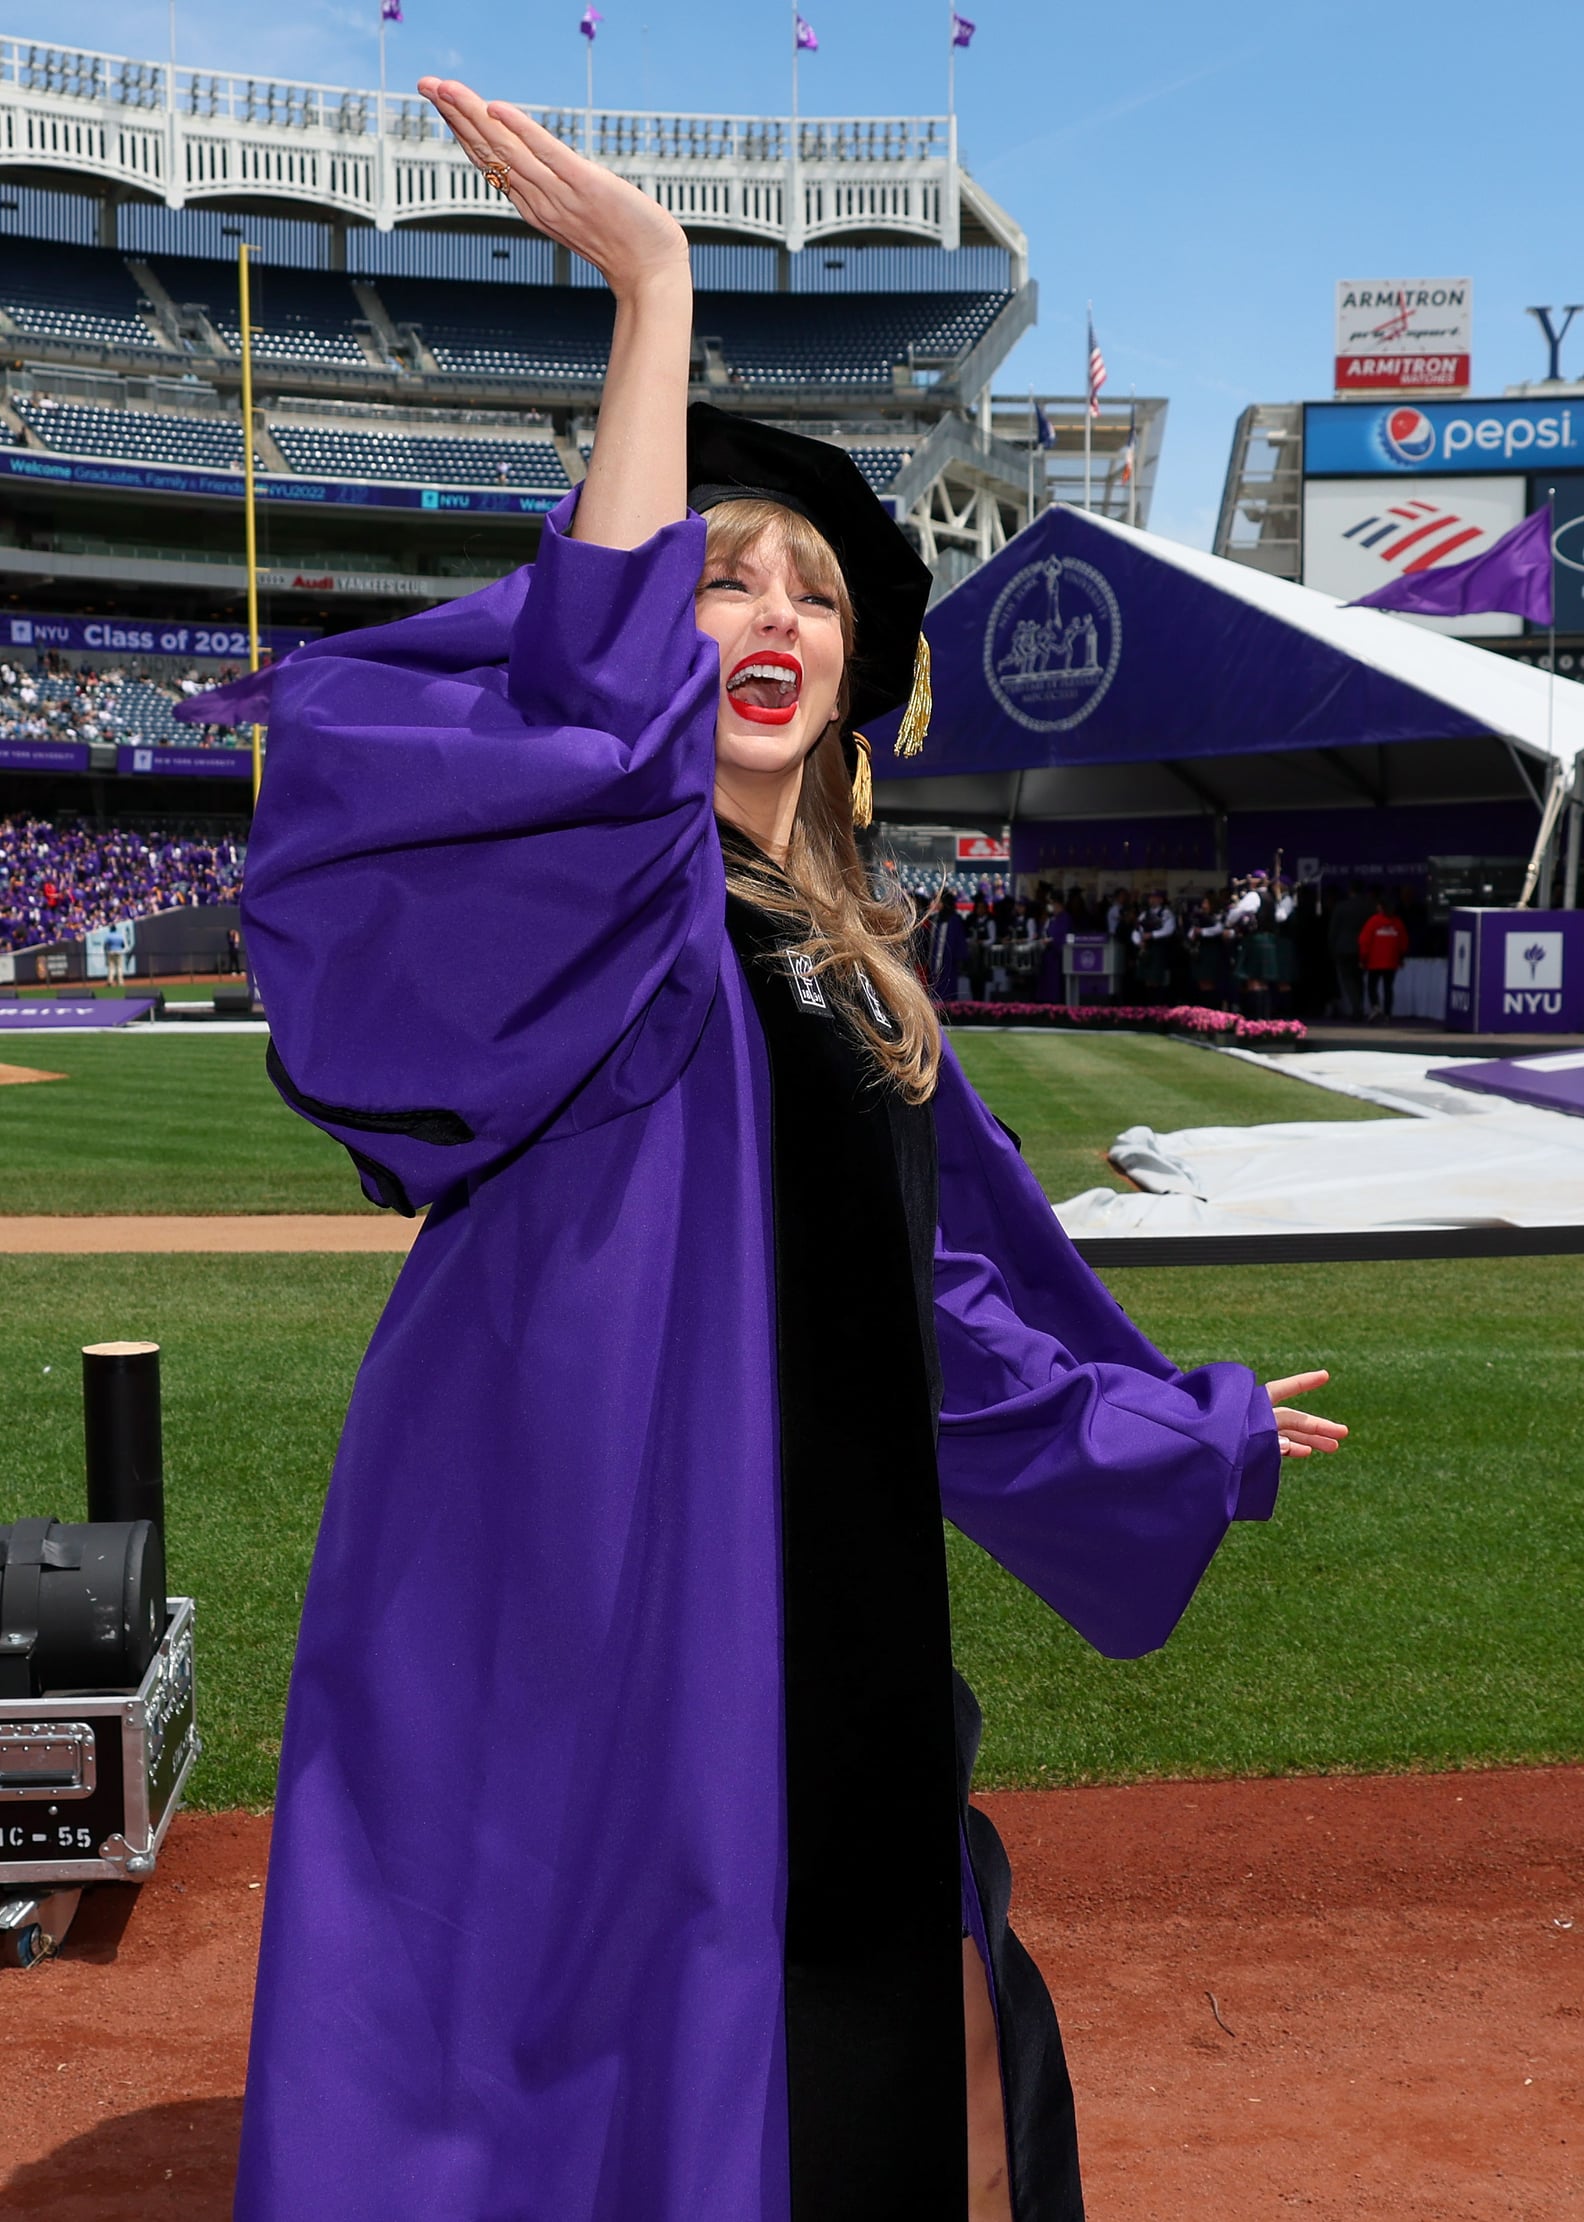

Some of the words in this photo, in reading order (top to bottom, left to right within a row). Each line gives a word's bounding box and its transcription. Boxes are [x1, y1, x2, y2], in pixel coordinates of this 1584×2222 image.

[1342, 288, 1466, 309] ARMITRON
[1346, 356, 1459, 377] ARMITRON
[1443, 409, 1572, 460] pepsi
[10, 457, 72, 480] Welcome
[145, 472, 187, 491] Family
[440, 494, 470, 508] NYU
[291, 573, 334, 590] Audi
[337, 576, 394, 593] YANKEES
[34, 625, 69, 641] NYU
[83, 624, 154, 650] Class
[160, 630, 189, 651] of
[1451, 989, 1471, 1012] NYU
[1503, 993, 1563, 1015] NYU
[58, 1826, 92, 1848] 55
